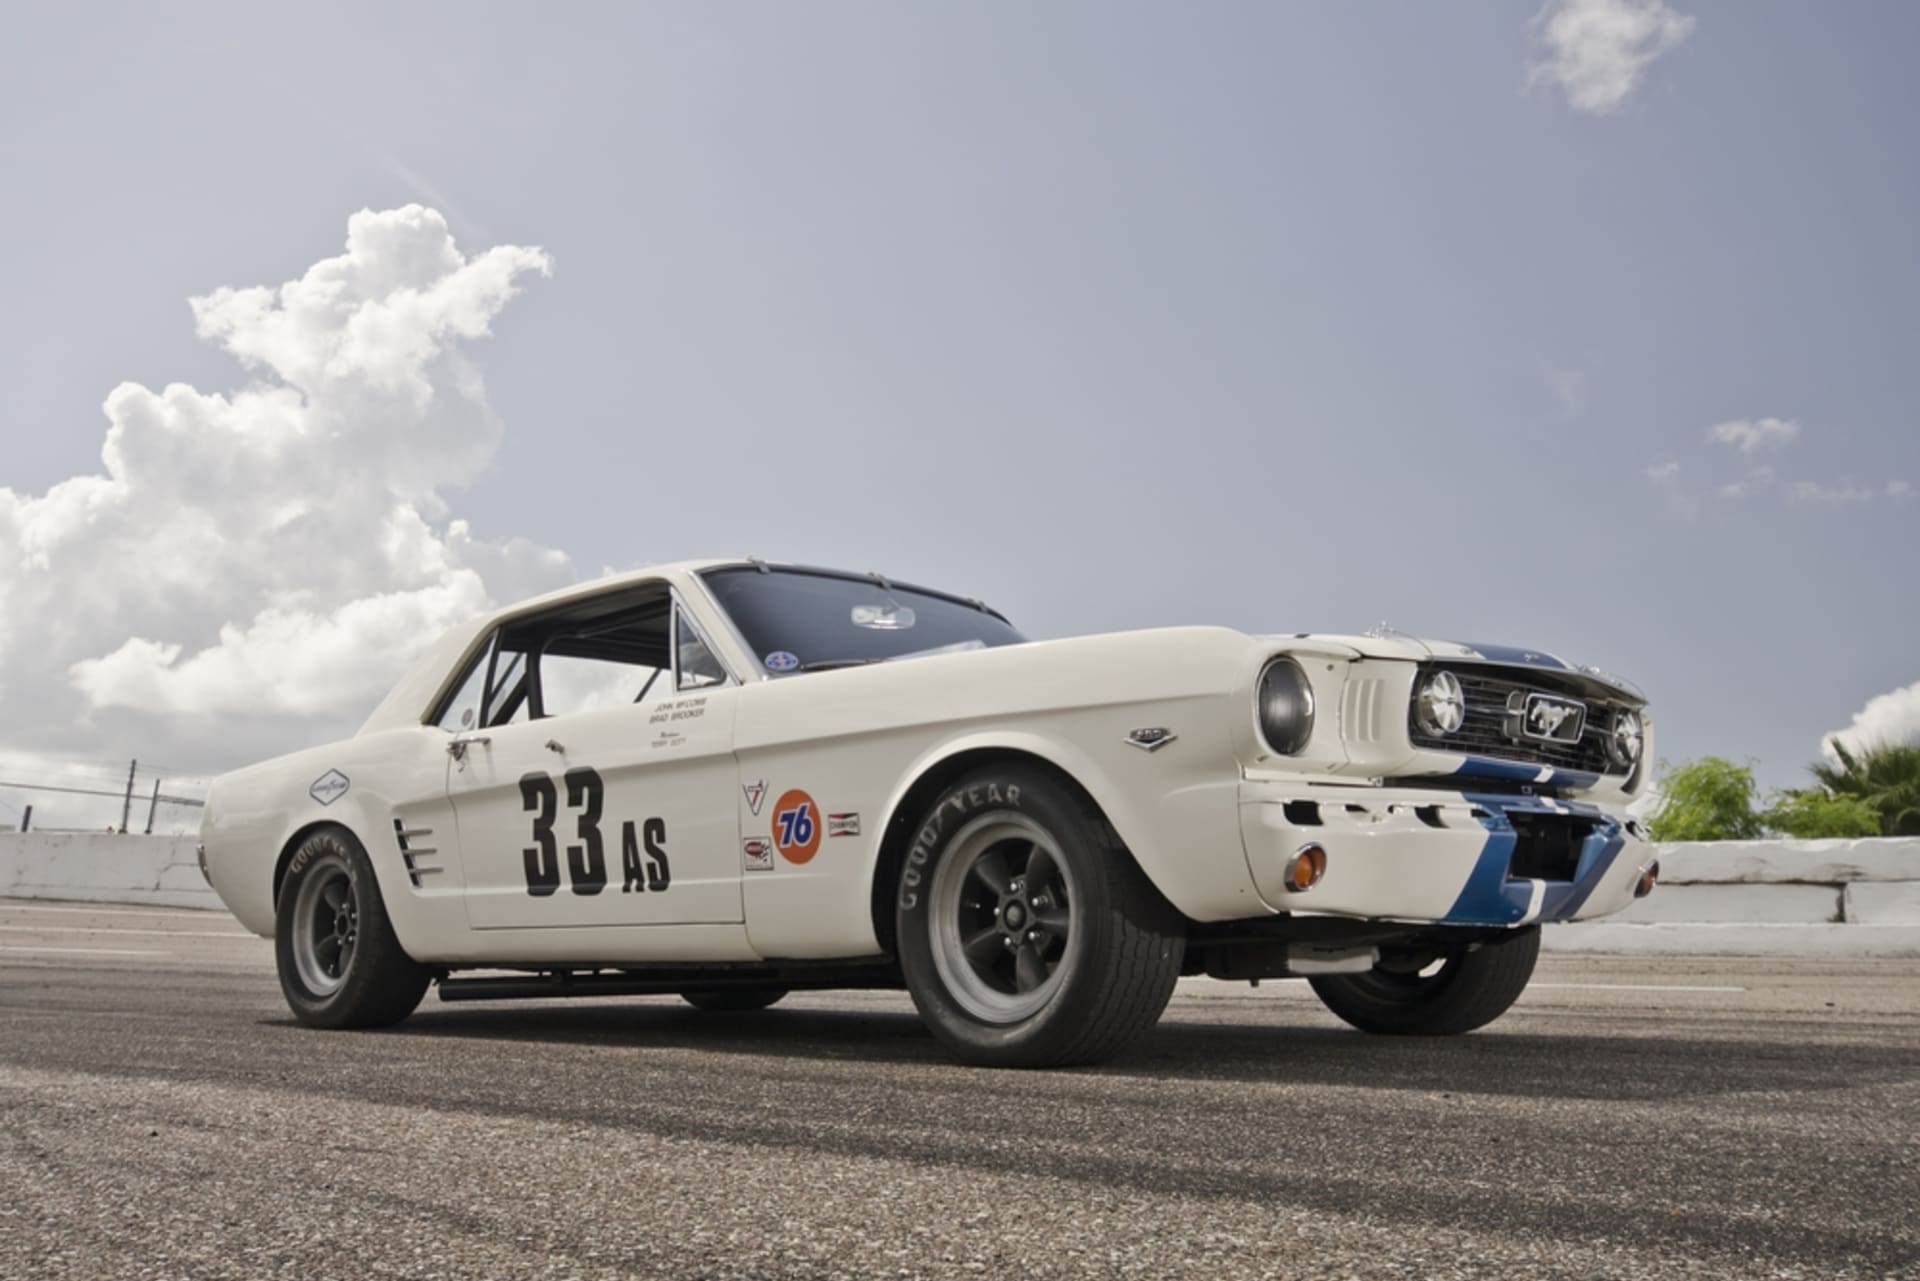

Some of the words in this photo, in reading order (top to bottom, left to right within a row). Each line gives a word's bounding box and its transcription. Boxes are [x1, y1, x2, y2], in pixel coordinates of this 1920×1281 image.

[519, 767, 607, 896] 33
[622, 818, 670, 893] AS
[778, 802, 813, 848] 76
